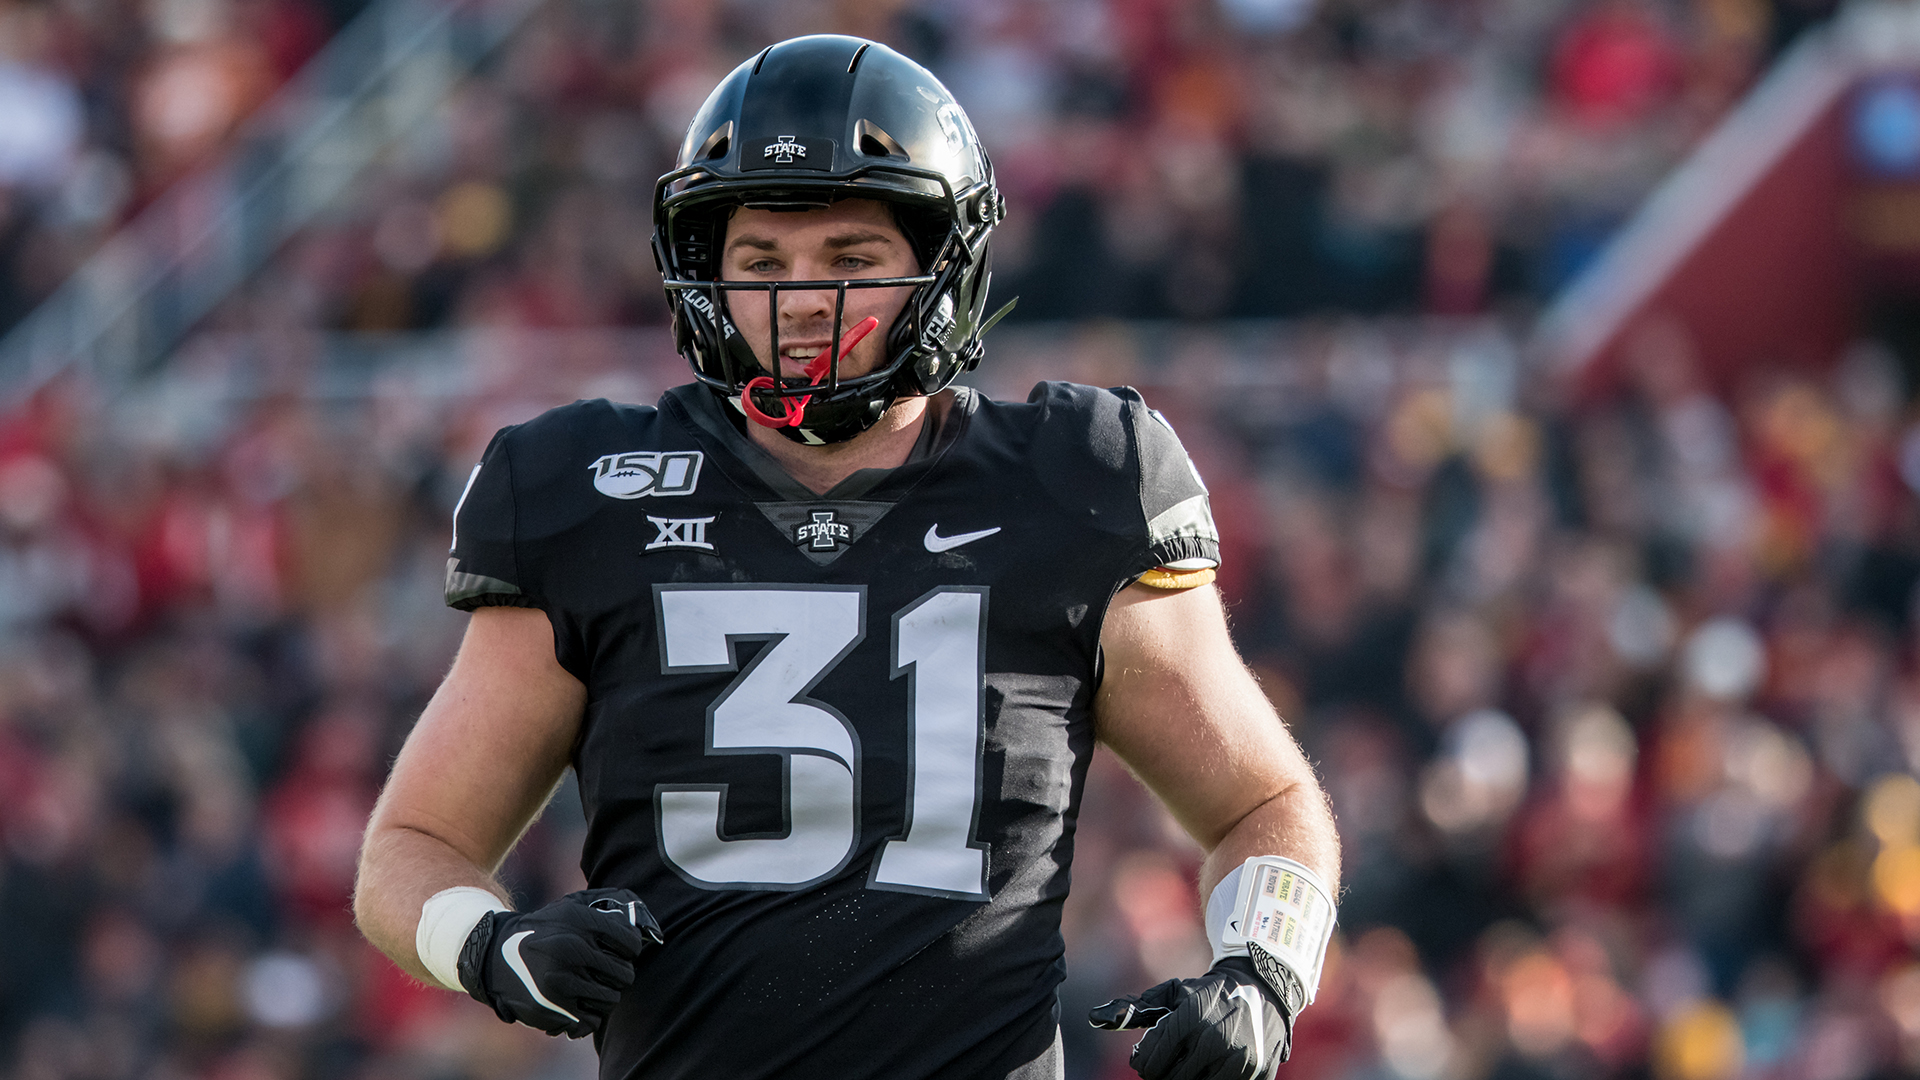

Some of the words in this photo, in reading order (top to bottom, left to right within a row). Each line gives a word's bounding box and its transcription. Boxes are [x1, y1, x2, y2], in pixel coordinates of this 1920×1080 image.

[763, 142, 807, 158] STATE
[588, 451, 704, 499] 150
[645, 513, 717, 551] XII
[797, 522, 850, 542] STATE
[651, 582, 992, 903] 31
[1266, 875, 1277, 893] ROVER
[1280, 879, 1290, 900] PIRATE
[1293, 886, 1303, 906] VEGAS
[1270, 916, 1282, 942] PATRIOT
[1284, 923, 1295, 947] FALCON
